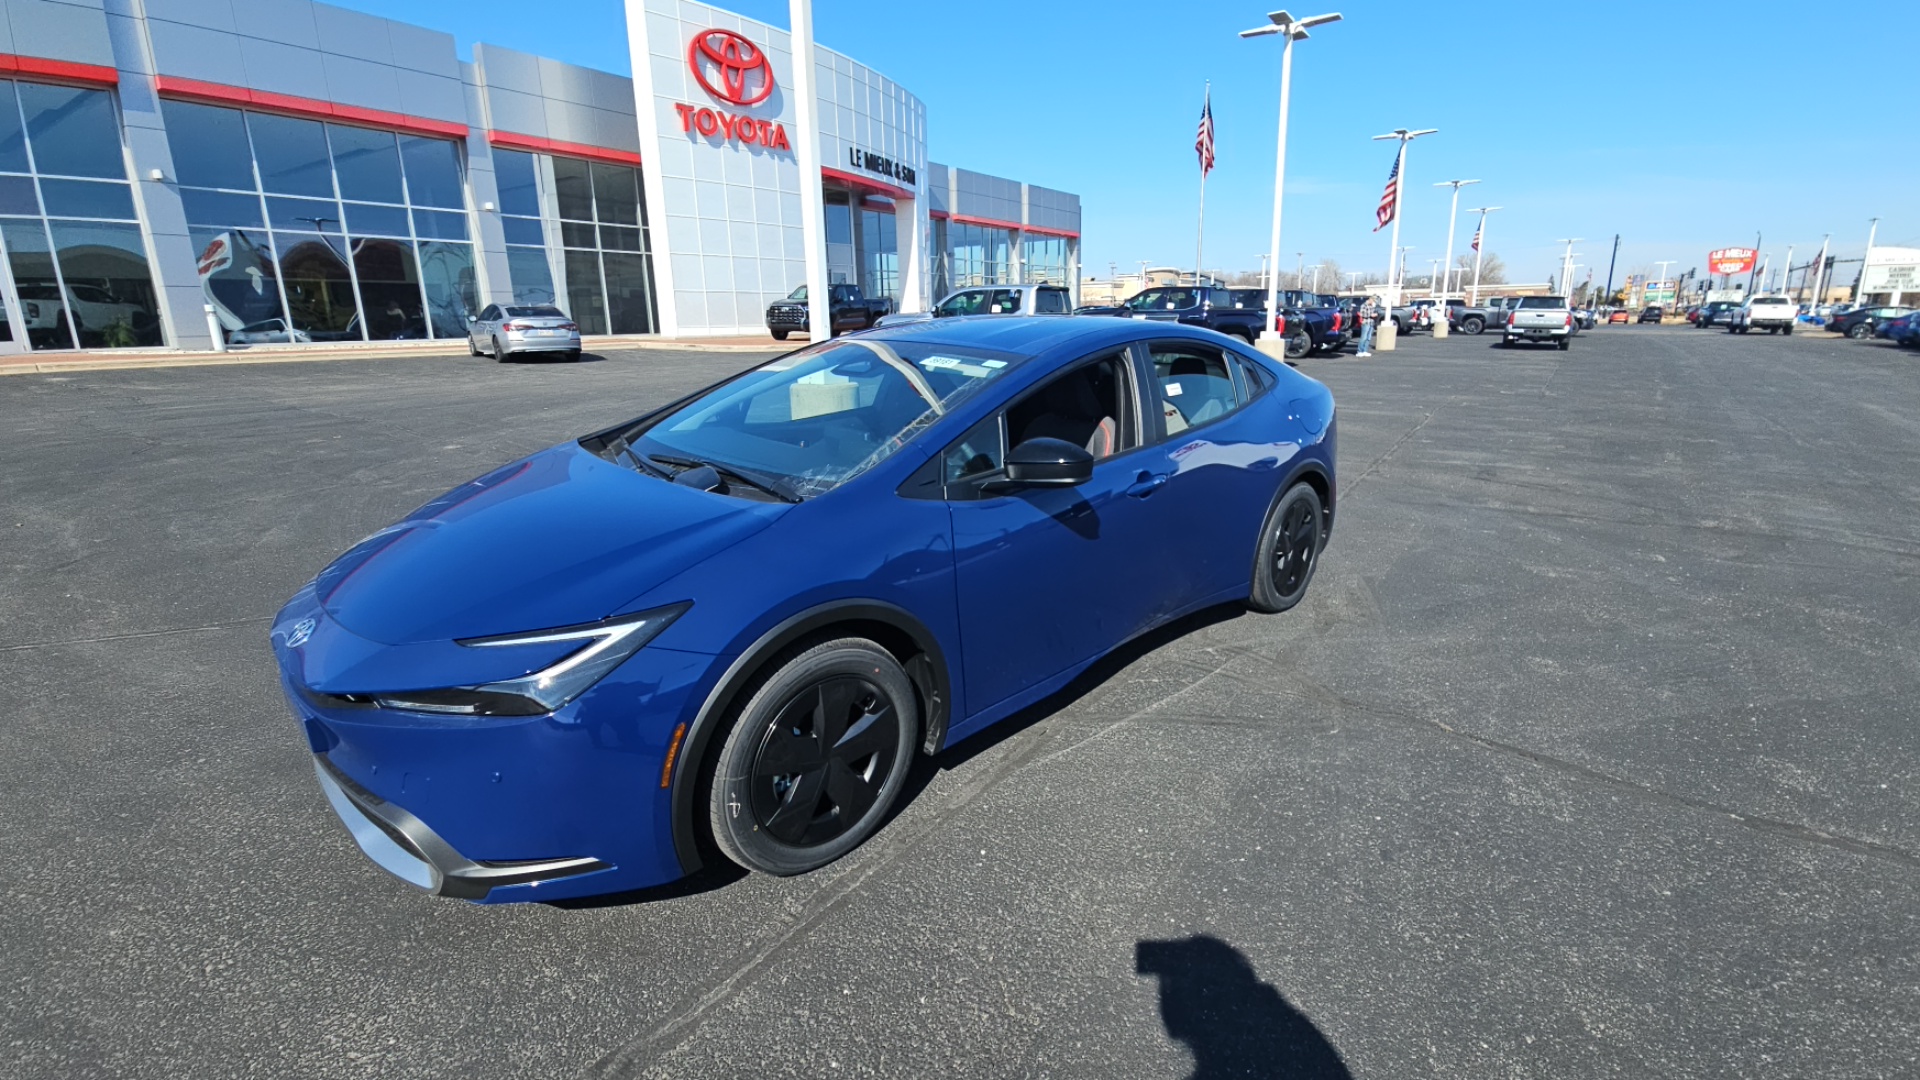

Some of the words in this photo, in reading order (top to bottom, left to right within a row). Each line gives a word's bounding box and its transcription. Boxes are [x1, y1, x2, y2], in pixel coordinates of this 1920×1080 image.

[674, 102, 790, 151] TOYOTA
[850, 147, 863, 168] LE
[864, 151, 893, 178] MIEUX
[895, 163, 902, 180] &
[1712, 251, 1723, 259] LE
[1724, 249, 1753, 258] MIEUX
